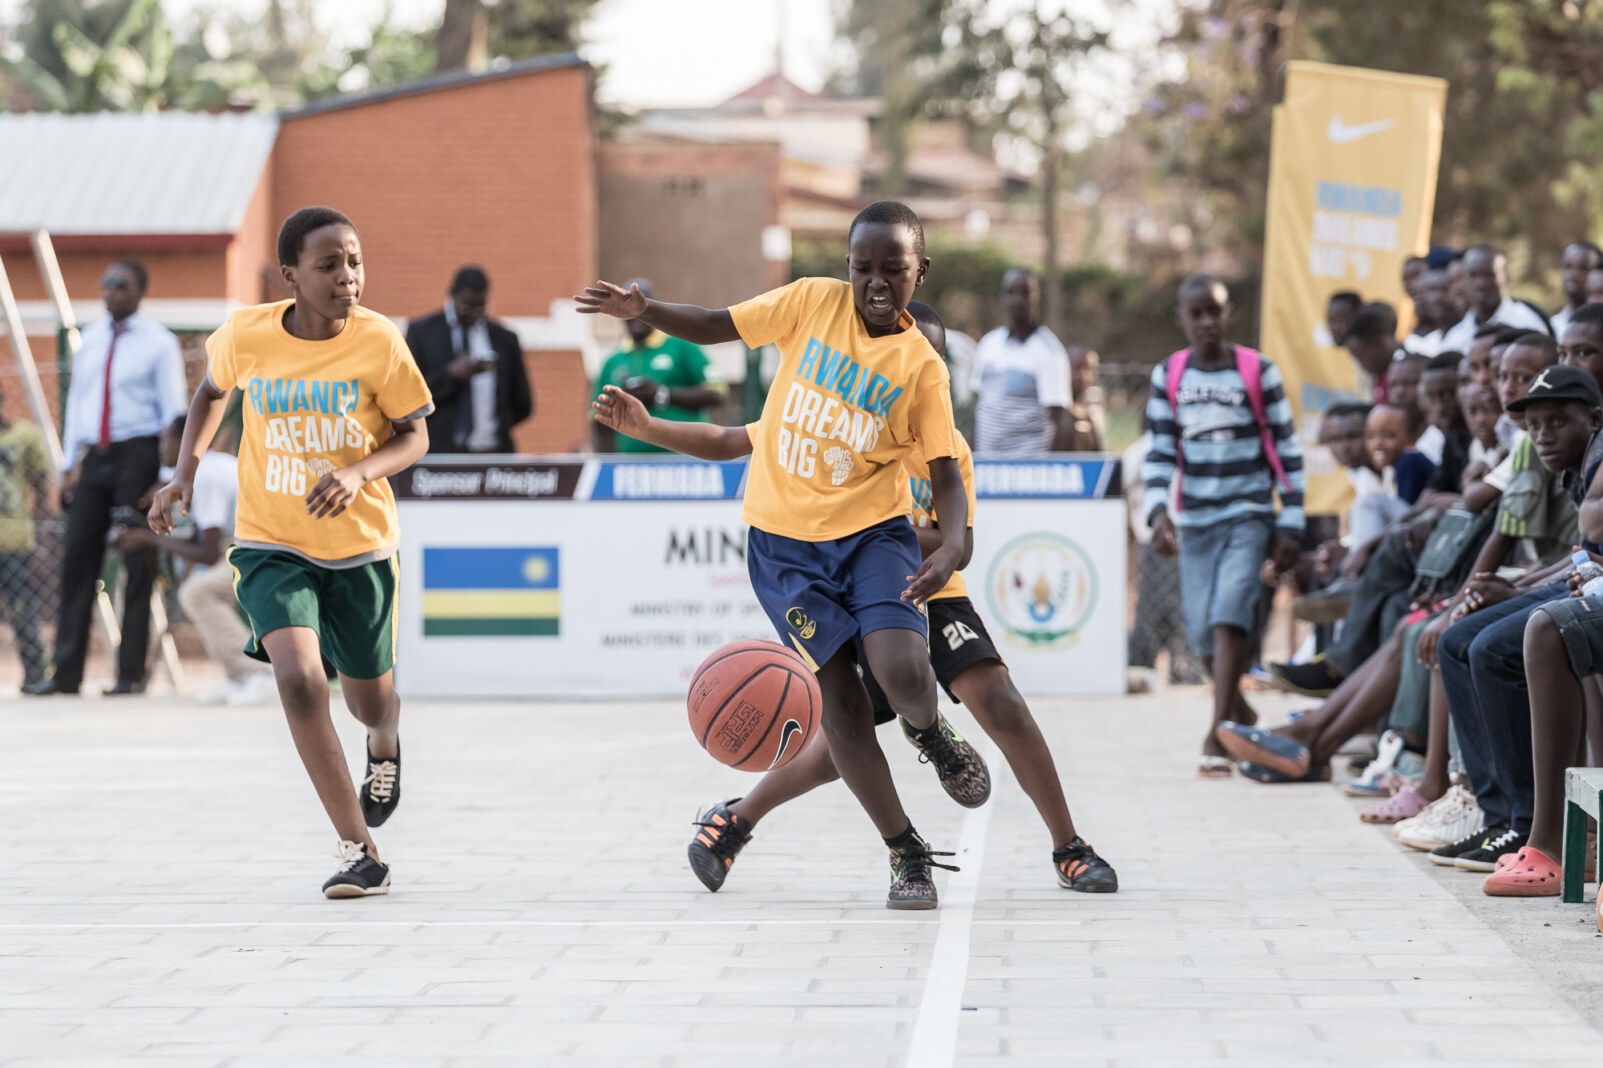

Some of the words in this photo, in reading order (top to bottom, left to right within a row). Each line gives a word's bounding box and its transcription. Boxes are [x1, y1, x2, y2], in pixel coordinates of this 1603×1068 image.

[249, 377, 359, 416] RWANDA
[796, 337, 903, 419] RWANDA
[265, 415, 363, 454] DREAMS
[782, 381, 885, 453] DREAMS
[778, 426, 818, 478] BIG
[265, 454, 307, 496] BIG
[412, 468, 484, 498] Sponsor
[486, 468, 559, 498] Principal
[665, 527, 747, 565] MIN
